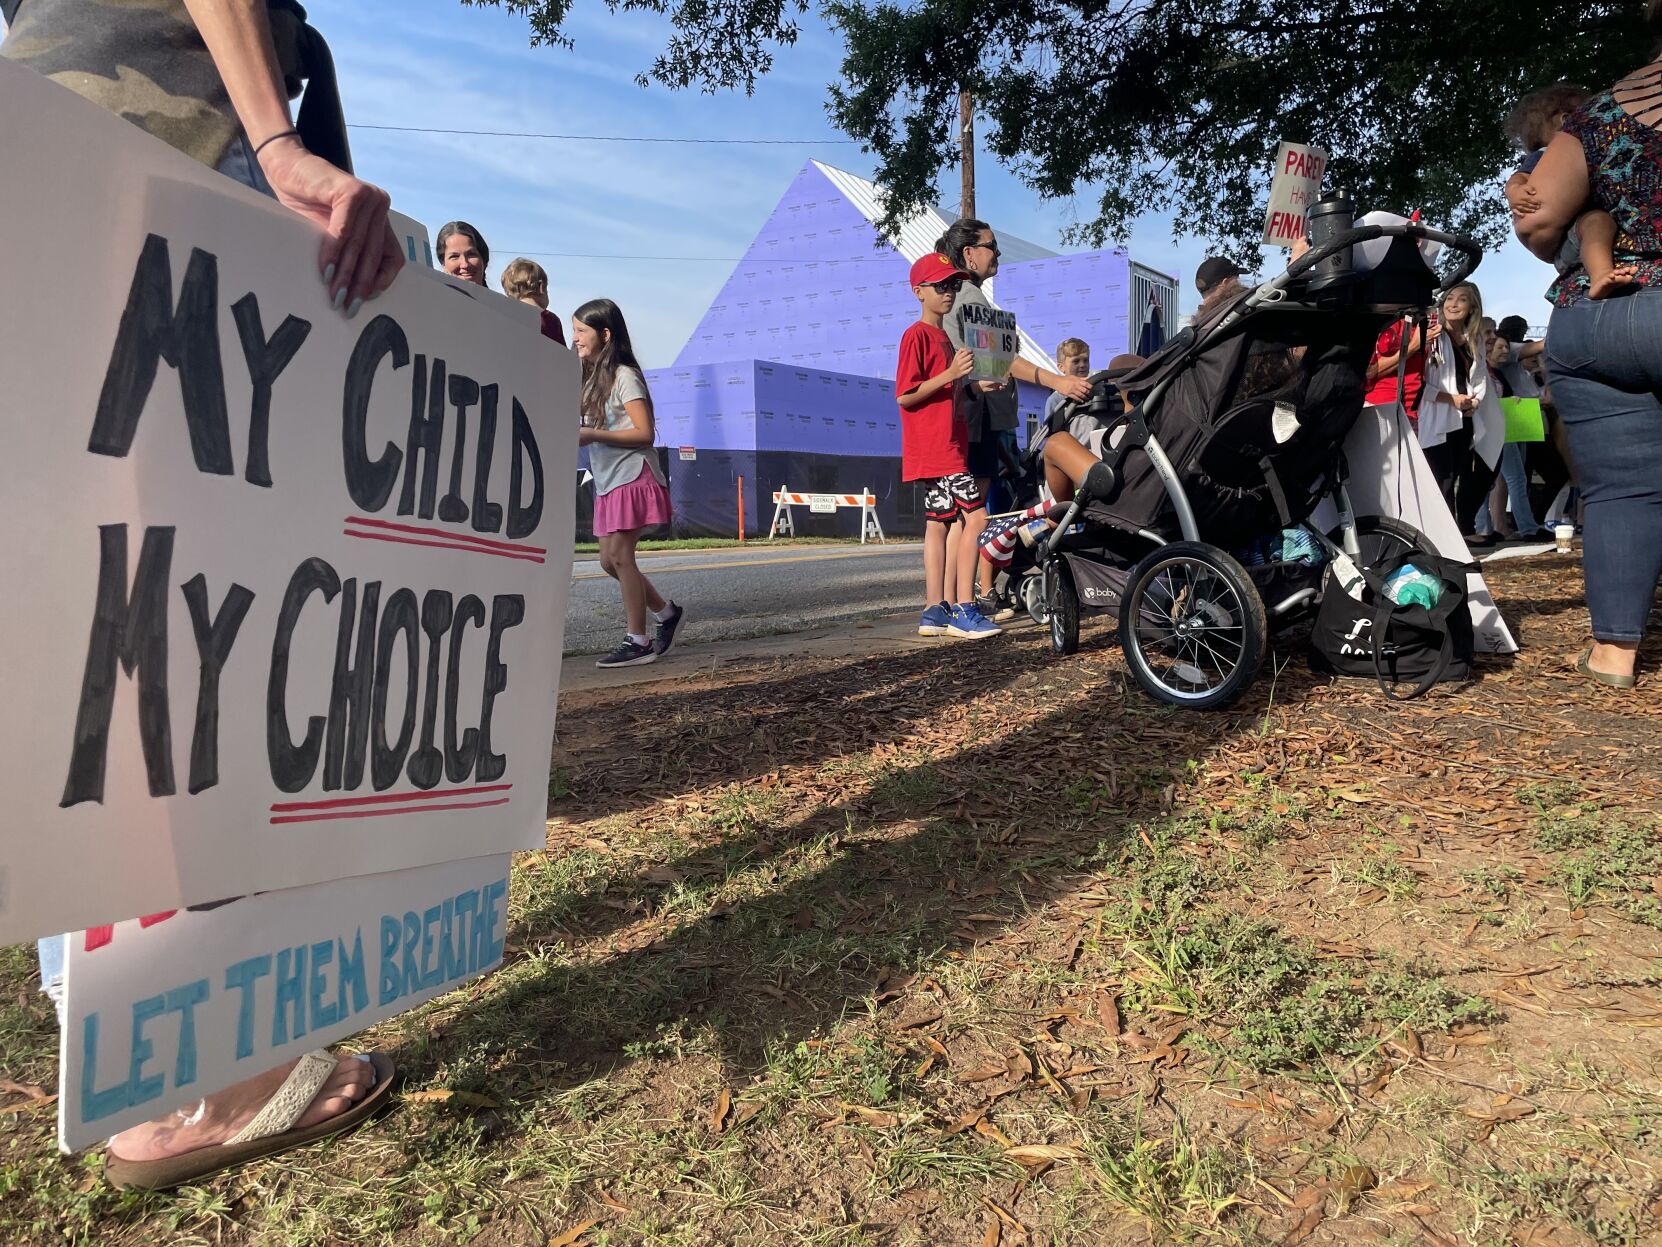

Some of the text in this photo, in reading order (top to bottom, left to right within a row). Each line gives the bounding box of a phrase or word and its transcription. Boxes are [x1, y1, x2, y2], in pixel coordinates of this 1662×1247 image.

[963, 304, 1015, 330] MASKING
[1002, 333, 1012, 352] IS
[87, 233, 545, 539] MY CHILD
[1096, 586, 1117, 600] baby
[58, 523, 525, 808] MY CHOICE
[81, 977, 210, 1123] LET
[225, 925, 370, 1061] THEM
[377, 878, 507, 1007] BREATHE
